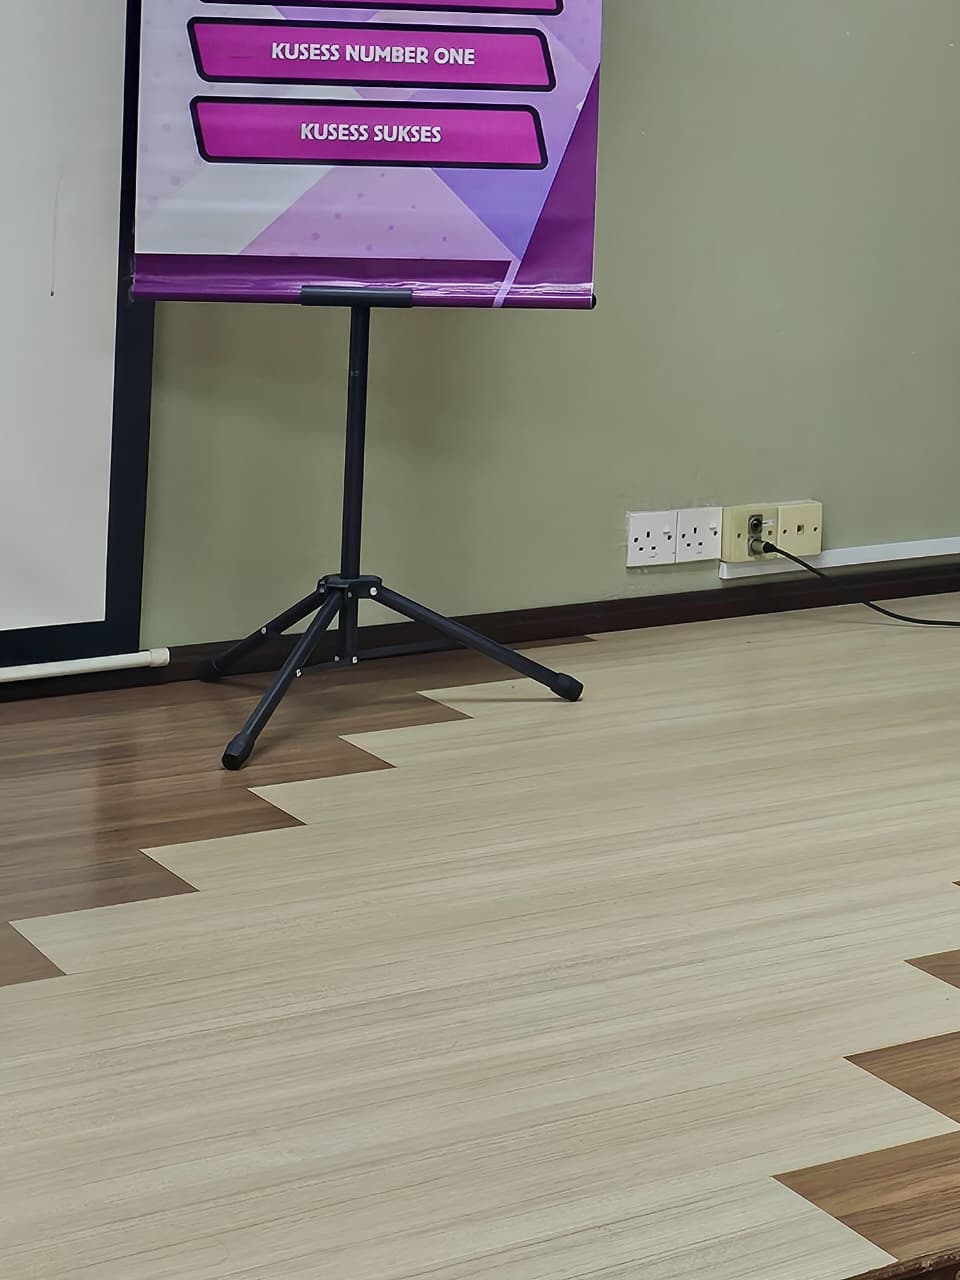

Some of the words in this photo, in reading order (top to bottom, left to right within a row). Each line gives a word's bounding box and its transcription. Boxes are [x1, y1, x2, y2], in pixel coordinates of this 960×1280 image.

[271, 42, 340, 61] KUSESS
[345, 44, 429, 63] NUMBER
[434, 47, 475, 65] ONE
[300, 122, 369, 141] KUSESS
[373, 124, 441, 142] SUKSES
